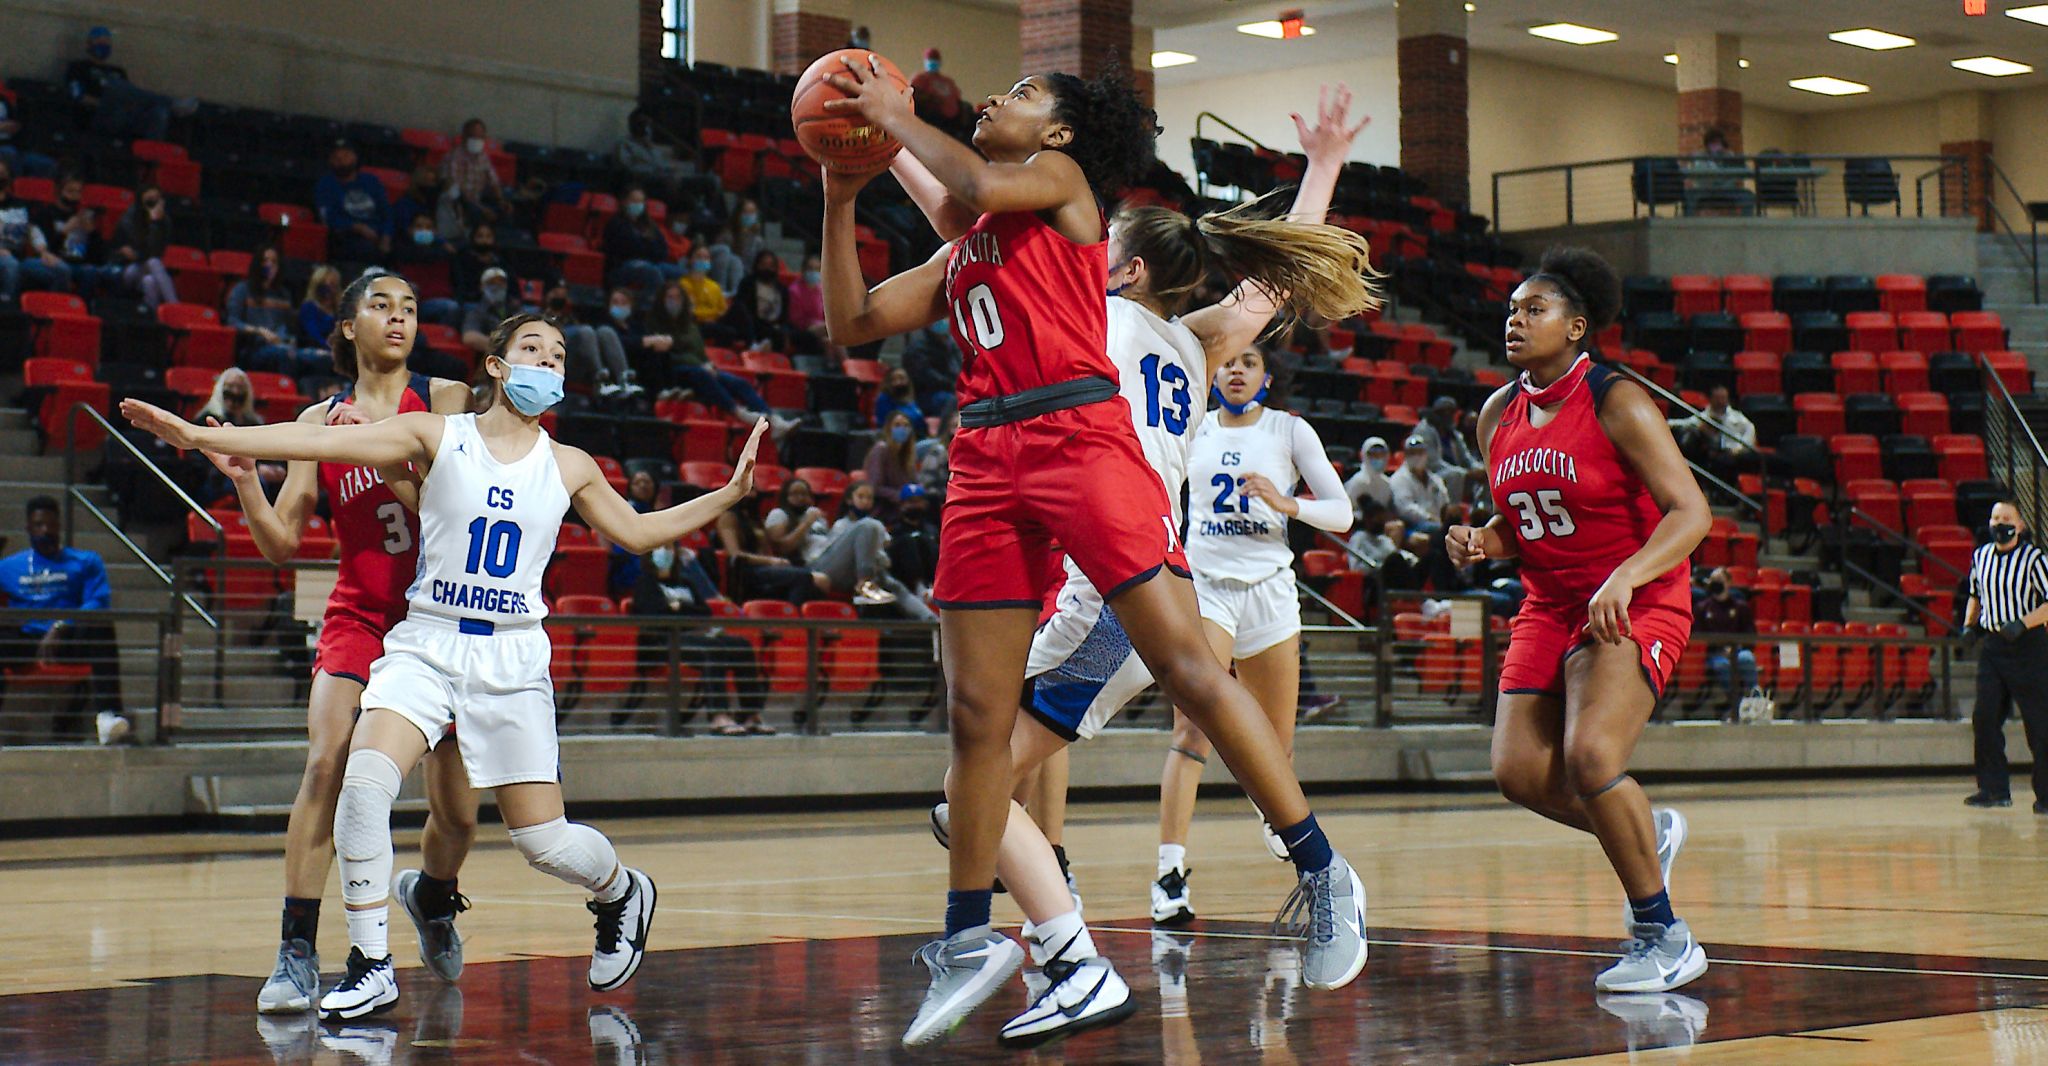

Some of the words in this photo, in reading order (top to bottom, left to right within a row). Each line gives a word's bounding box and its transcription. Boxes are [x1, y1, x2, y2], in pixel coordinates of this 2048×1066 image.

[1139, 352, 1192, 436] 13
[1221, 451, 1241, 466] CS
[1494, 447, 1578, 489] ATASCOCITA
[487, 486, 514, 510] CS
[1507, 489, 1577, 541] 35
[376, 502, 412, 554] 3
[465, 516, 522, 578] 10
[432, 579, 530, 614] CHARGERS
